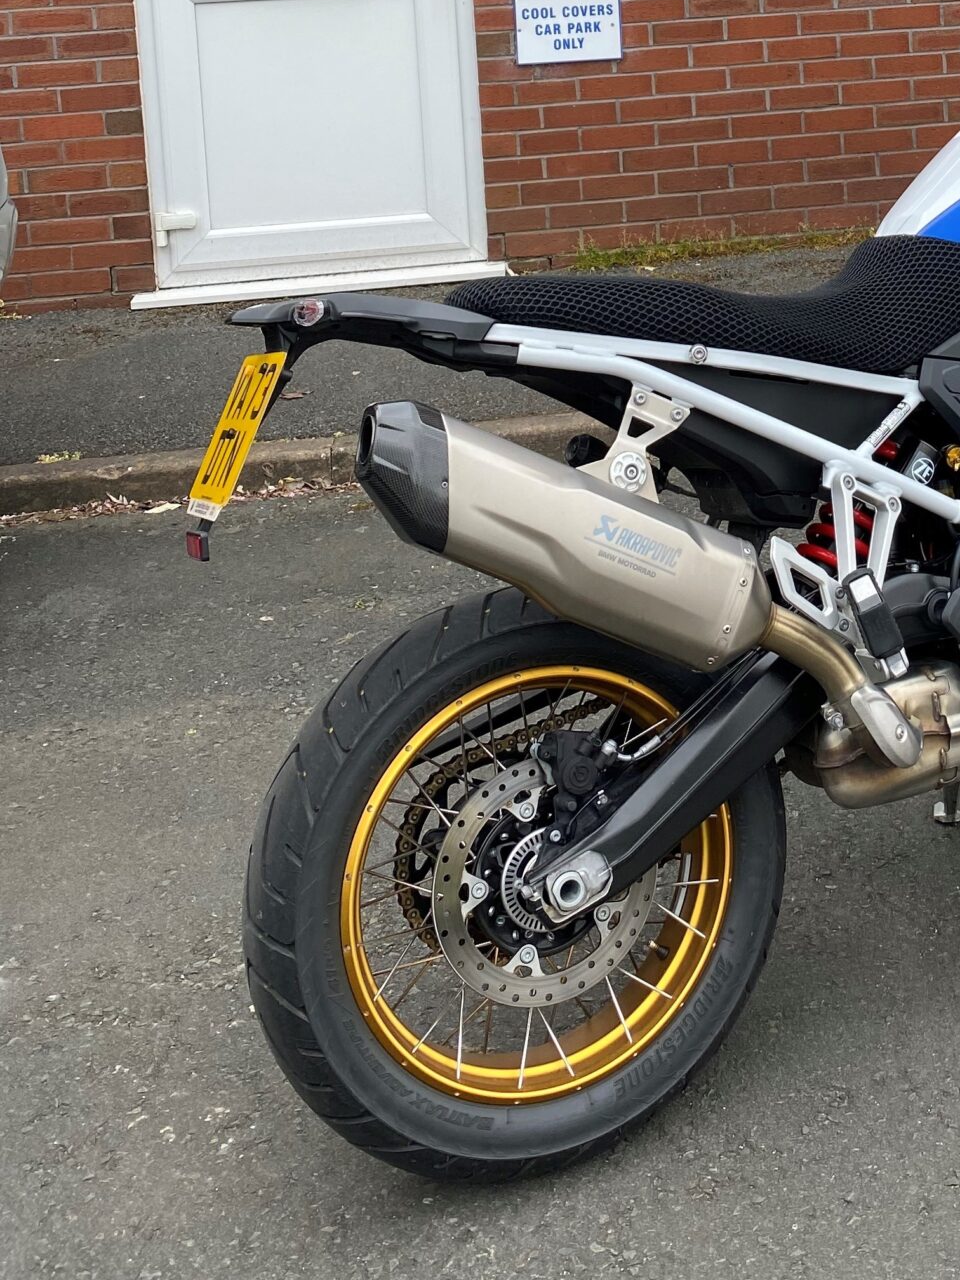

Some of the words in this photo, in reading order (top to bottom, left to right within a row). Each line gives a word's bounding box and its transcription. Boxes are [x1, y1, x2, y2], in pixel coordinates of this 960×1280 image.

[521, 6, 556, 20] COOL
[562, 3, 614, 18] COVERS
[535, 23, 561, 36] CAR
[567, 22, 601, 34] PARK
[553, 37, 585, 50] ONLY
[226, 362, 277, 420] VA73
[201, 427, 247, 489] DTN
[912, 458, 934, 484] ZF
